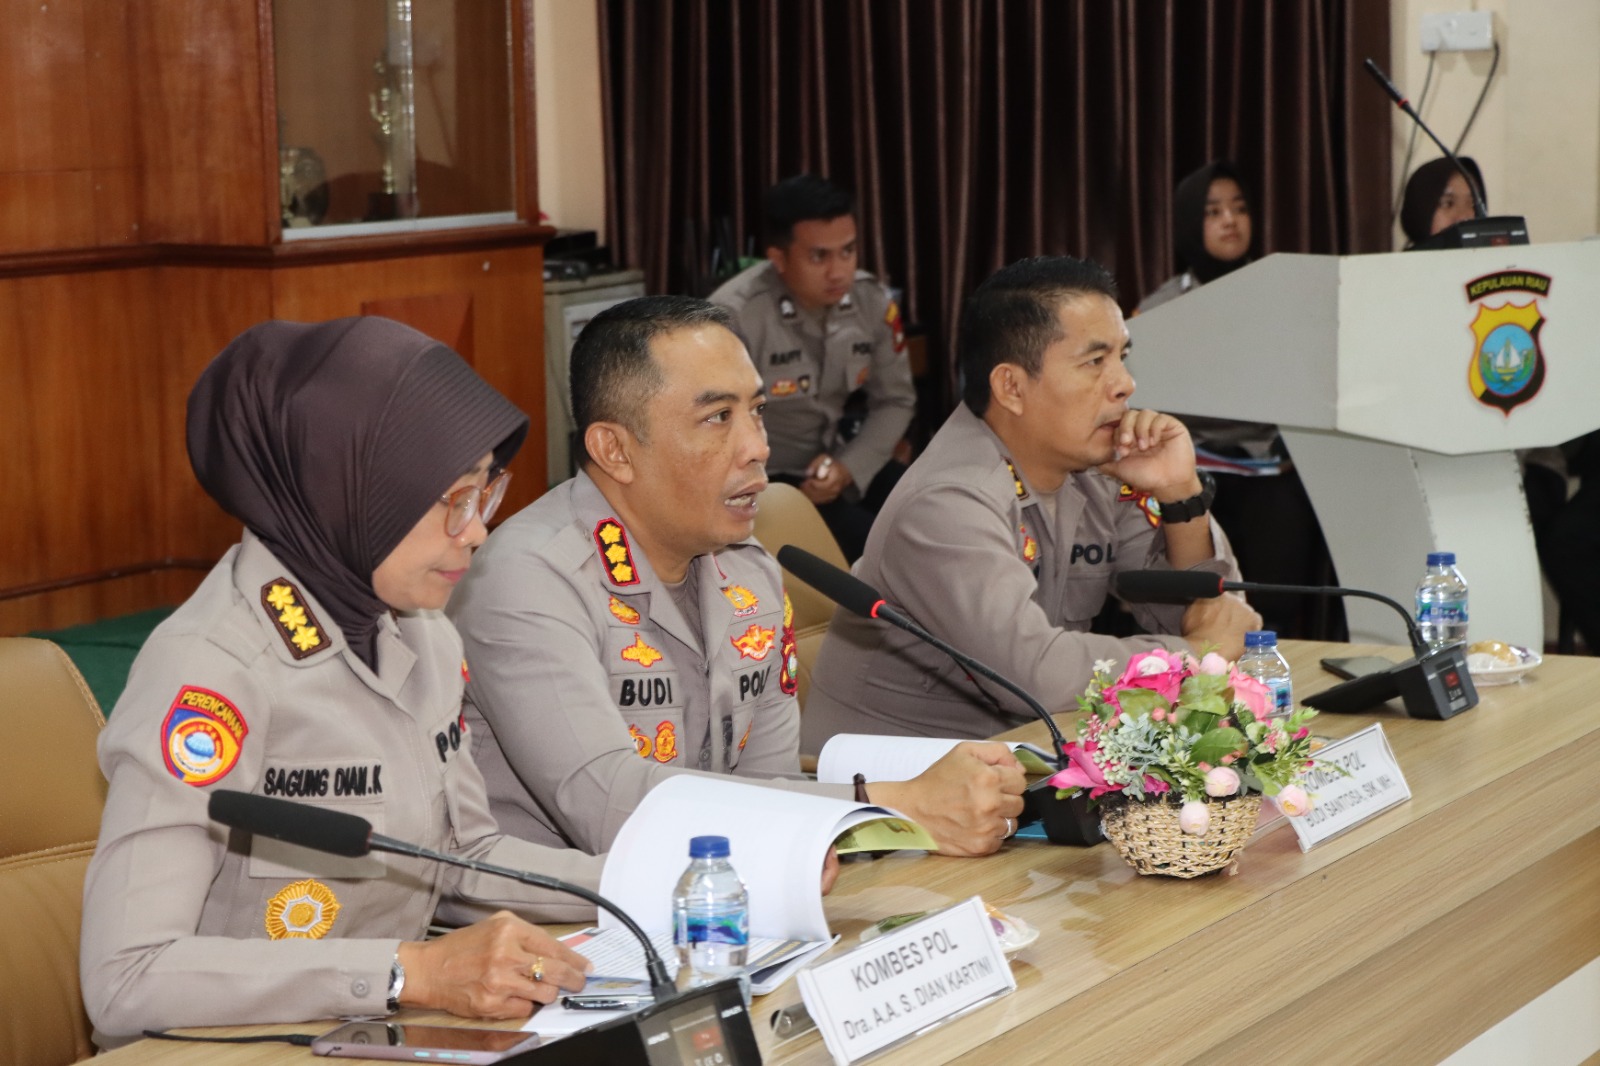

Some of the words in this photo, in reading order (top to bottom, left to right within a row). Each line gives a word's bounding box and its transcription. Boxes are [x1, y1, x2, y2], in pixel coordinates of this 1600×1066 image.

[1469, 275, 1524, 296] KEPULAUAN
[1525, 275, 1548, 291] RIAU
[619, 677, 673, 706] BUDI
[263, 767, 330, 798] SAGUNG
[850, 941, 923, 992] KOMBES
[921, 929, 958, 960] POL
[843, 1019, 873, 1040] Dra.
[915, 981, 948, 1007] DIAN
[948, 956, 995, 993] KARTINI
